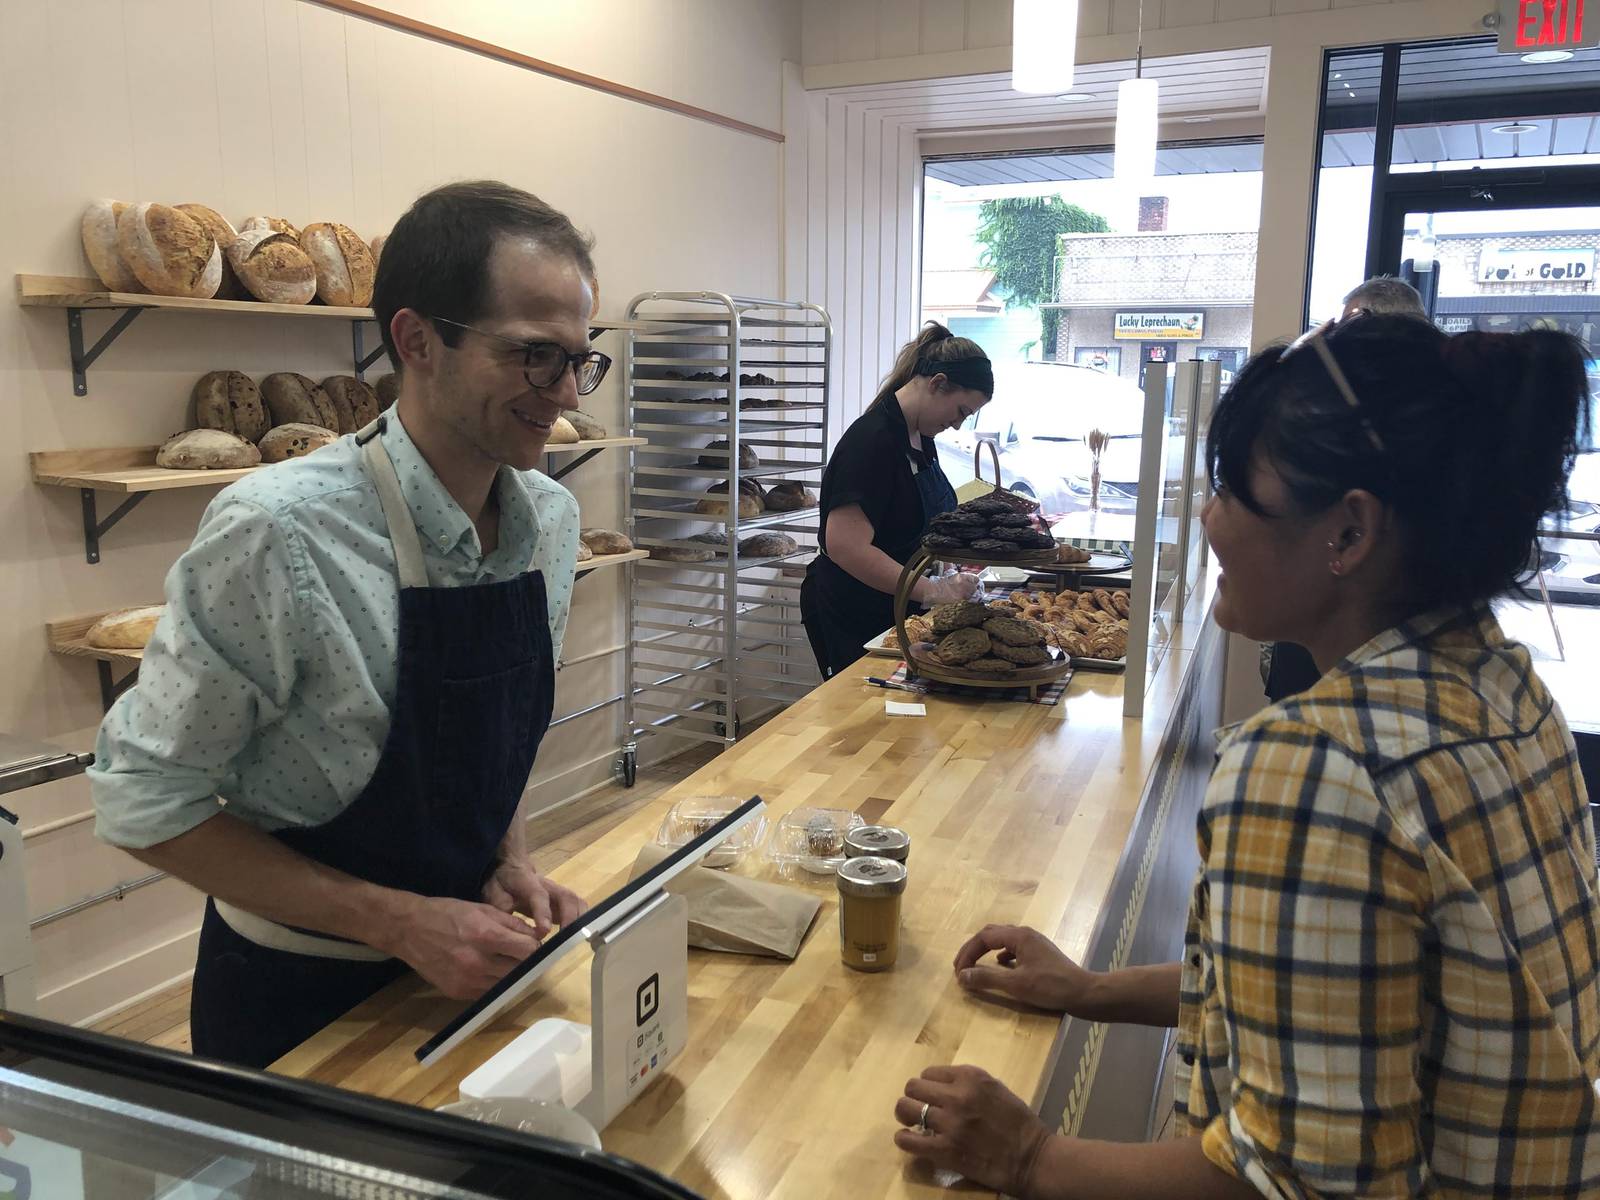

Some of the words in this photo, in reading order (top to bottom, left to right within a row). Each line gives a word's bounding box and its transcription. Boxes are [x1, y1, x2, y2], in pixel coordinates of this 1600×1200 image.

[1539, 262, 1586, 279] GOLD
[1119, 315, 1140, 328] Lucky
[1140, 315, 1181, 328] Leprechaun
